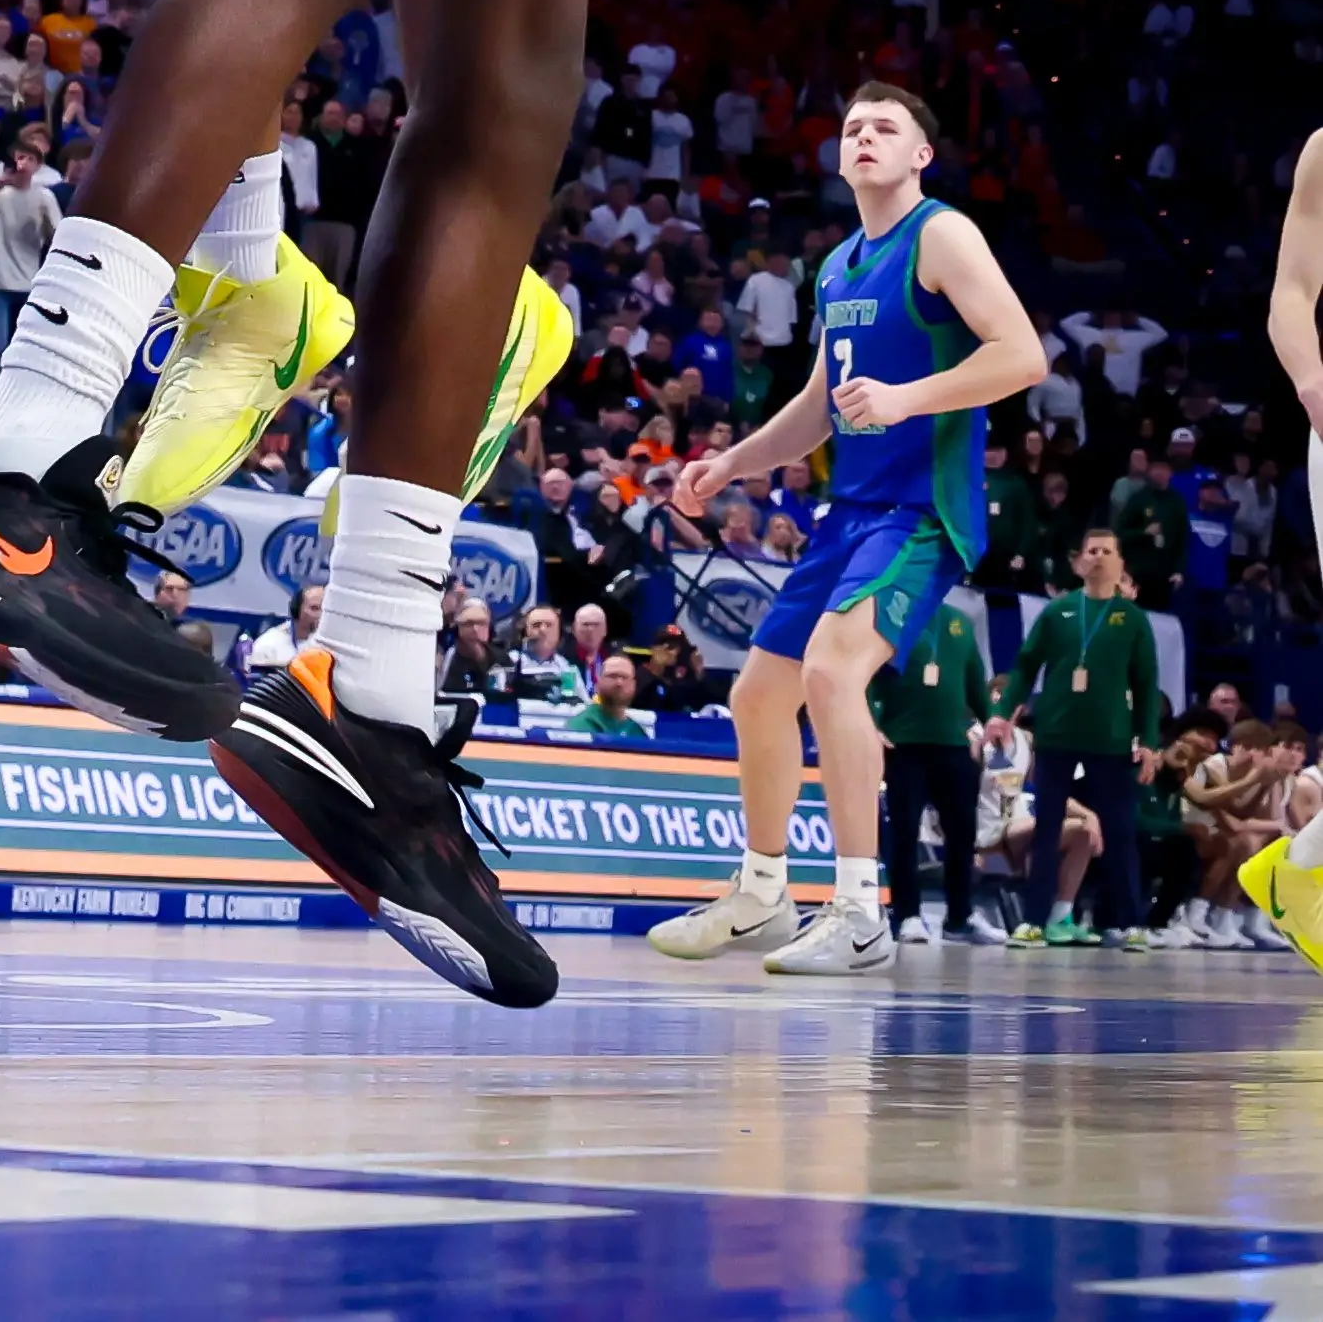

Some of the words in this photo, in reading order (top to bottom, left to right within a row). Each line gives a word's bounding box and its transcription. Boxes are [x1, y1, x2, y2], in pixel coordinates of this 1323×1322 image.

[0, 762, 168, 819] FISHING
[171, 774, 266, 824] LICE
[471, 792, 589, 842] TICKET
[590, 800, 641, 845] TO
[640, 804, 706, 847] THE
